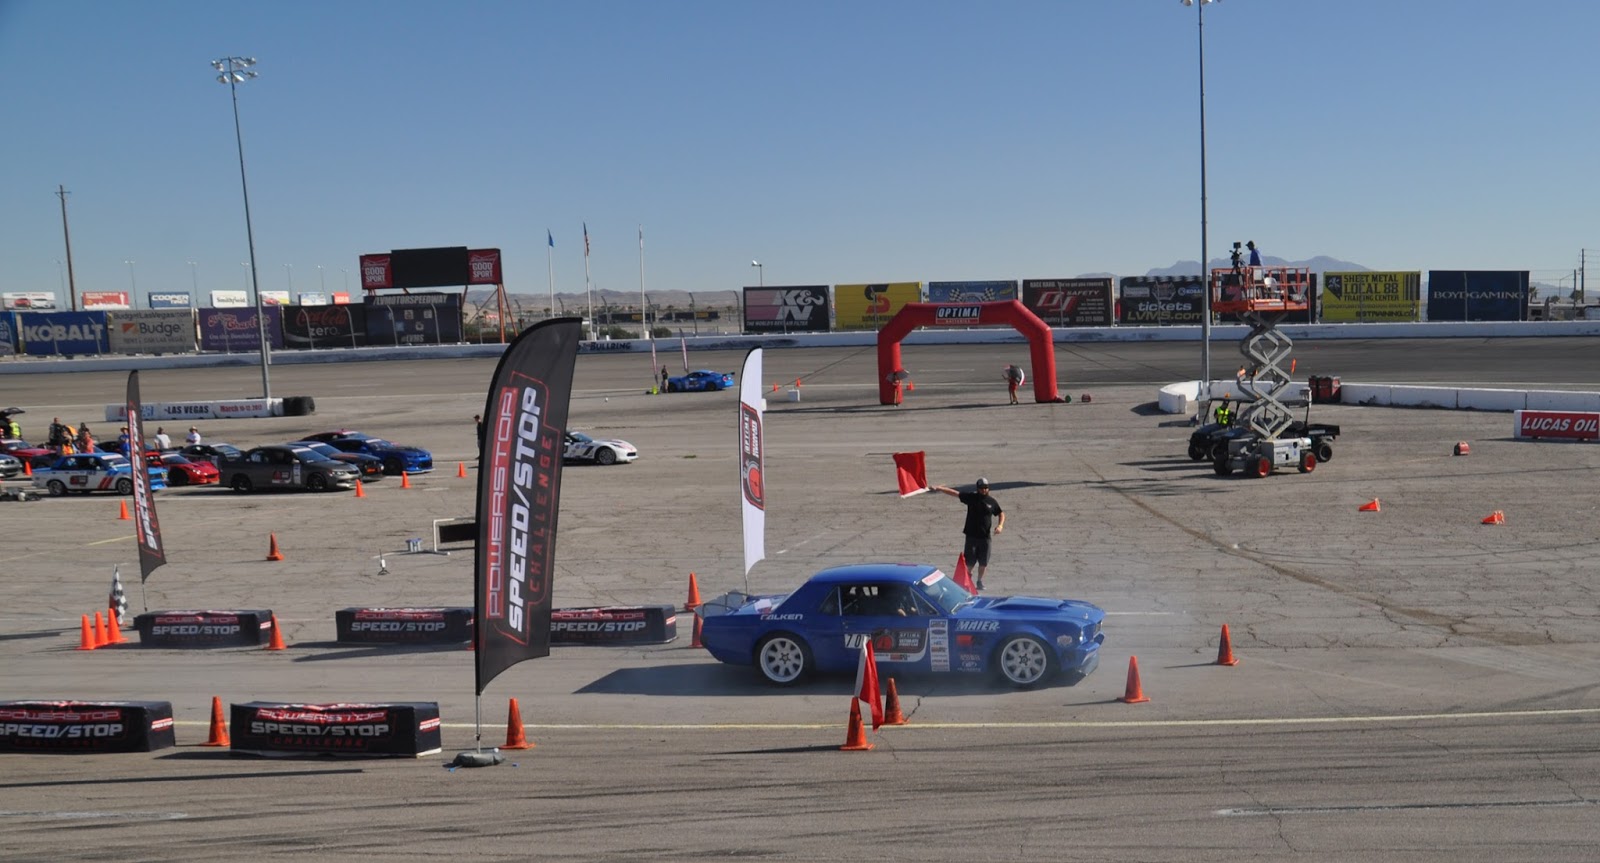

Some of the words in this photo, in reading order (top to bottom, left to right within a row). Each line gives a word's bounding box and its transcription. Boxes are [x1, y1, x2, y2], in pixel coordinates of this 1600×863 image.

[364, 266, 386, 276] GOOD
[472, 262, 493, 271] GOOD
[365, 275, 386, 283] SPORT
[472, 270, 493, 278] SPORT
[1343, 274, 1369, 283] SHEET
[1371, 274, 1399, 283] METAL
[1344, 283, 1382, 295] LOCAL
[1375, 294, 1400, 302] CENTER
[1138, 301, 1192, 312] tickets
[938, 307, 978, 318] OPTIMA
[23, 324, 104, 342] KOBALT
[590, 341, 632, 350] BULLRING
[184, 405, 209, 414] VEGAS
[219, 404, 239, 413] March
[1522, 417, 1571, 431] LUCAS
[1573, 419, 1598, 432] OIL
[488, 390, 514, 618] POWERSTOP
[508, 385, 542, 633] SPEED/STOP
[529, 436, 553, 593] CHALLENGE
[760, 613, 804, 621] FALKEN
[151, 625, 241, 636] SPEED/STOP
[350, 621, 447, 632] SPEED/STOP
[550, 621, 647, 632] SPEED/STOP
[957, 620, 1000, 632] MAIER
[0, 710, 120, 721] POWERSTOP
[257, 709, 386, 722] POWERSTOP
[251, 721, 390, 736] SPEED/STOP
